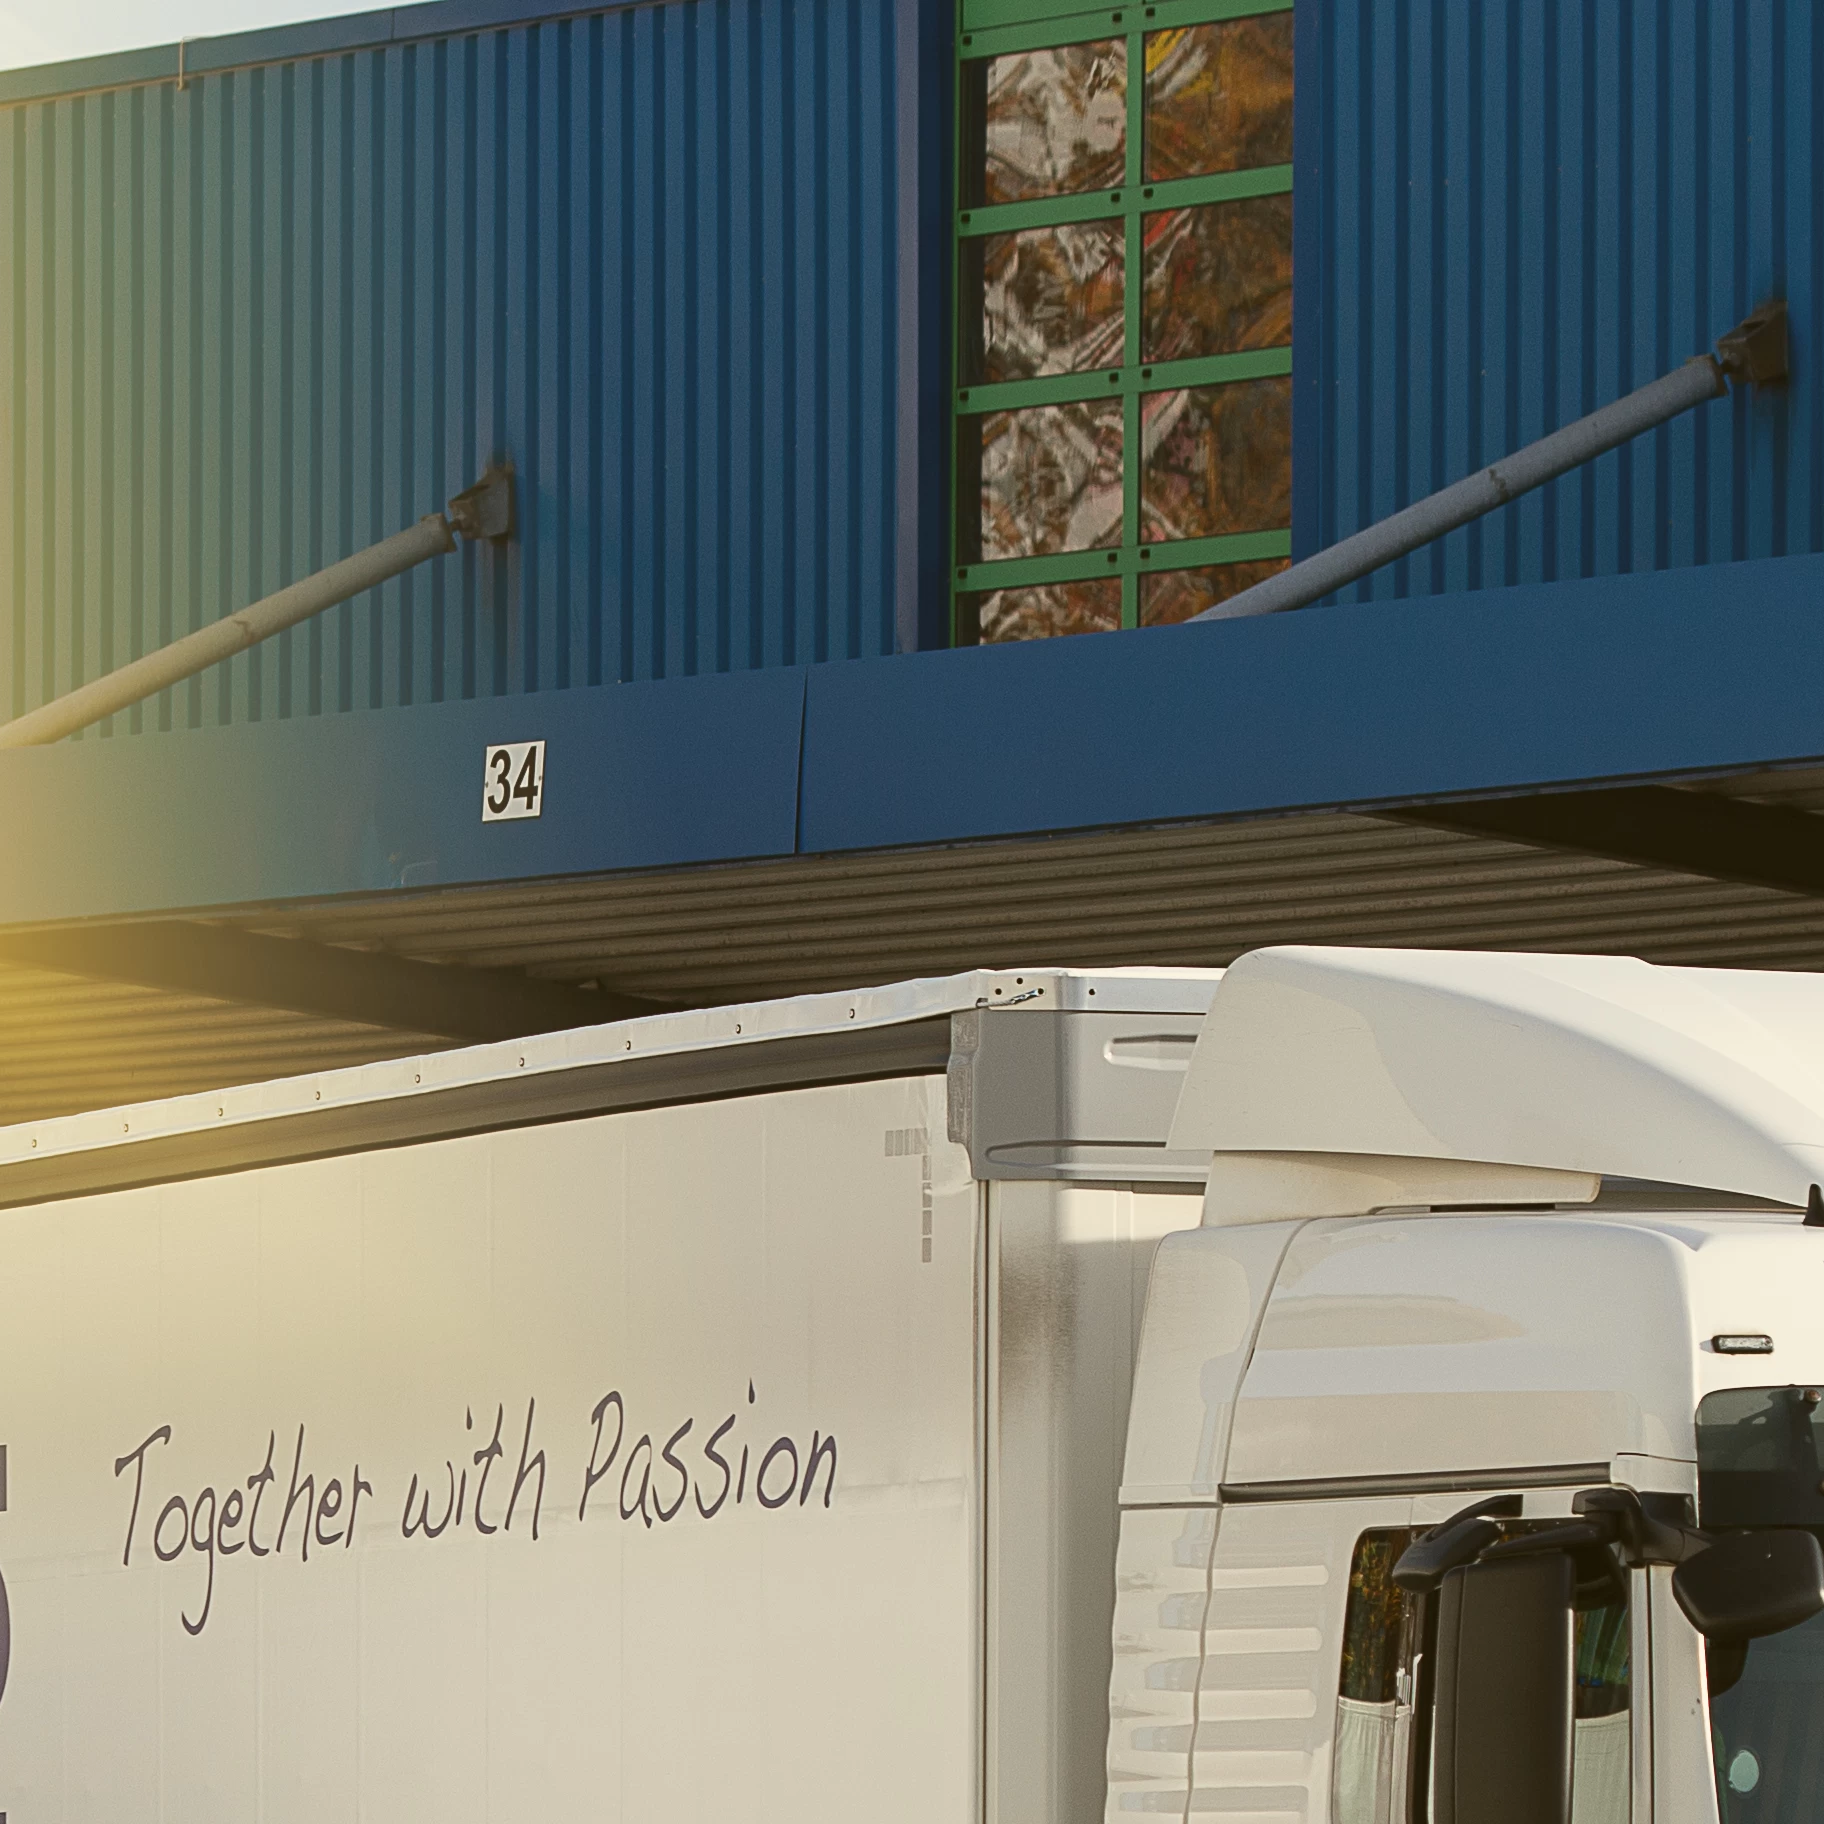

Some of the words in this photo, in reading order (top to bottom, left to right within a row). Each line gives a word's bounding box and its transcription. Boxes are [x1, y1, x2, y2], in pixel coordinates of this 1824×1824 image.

[487, 745, 539, 814] 34
[114, 1422, 372, 1636] Together
[402, 1396, 547, 1541] with
[578, 1377, 838, 1528] Passion
